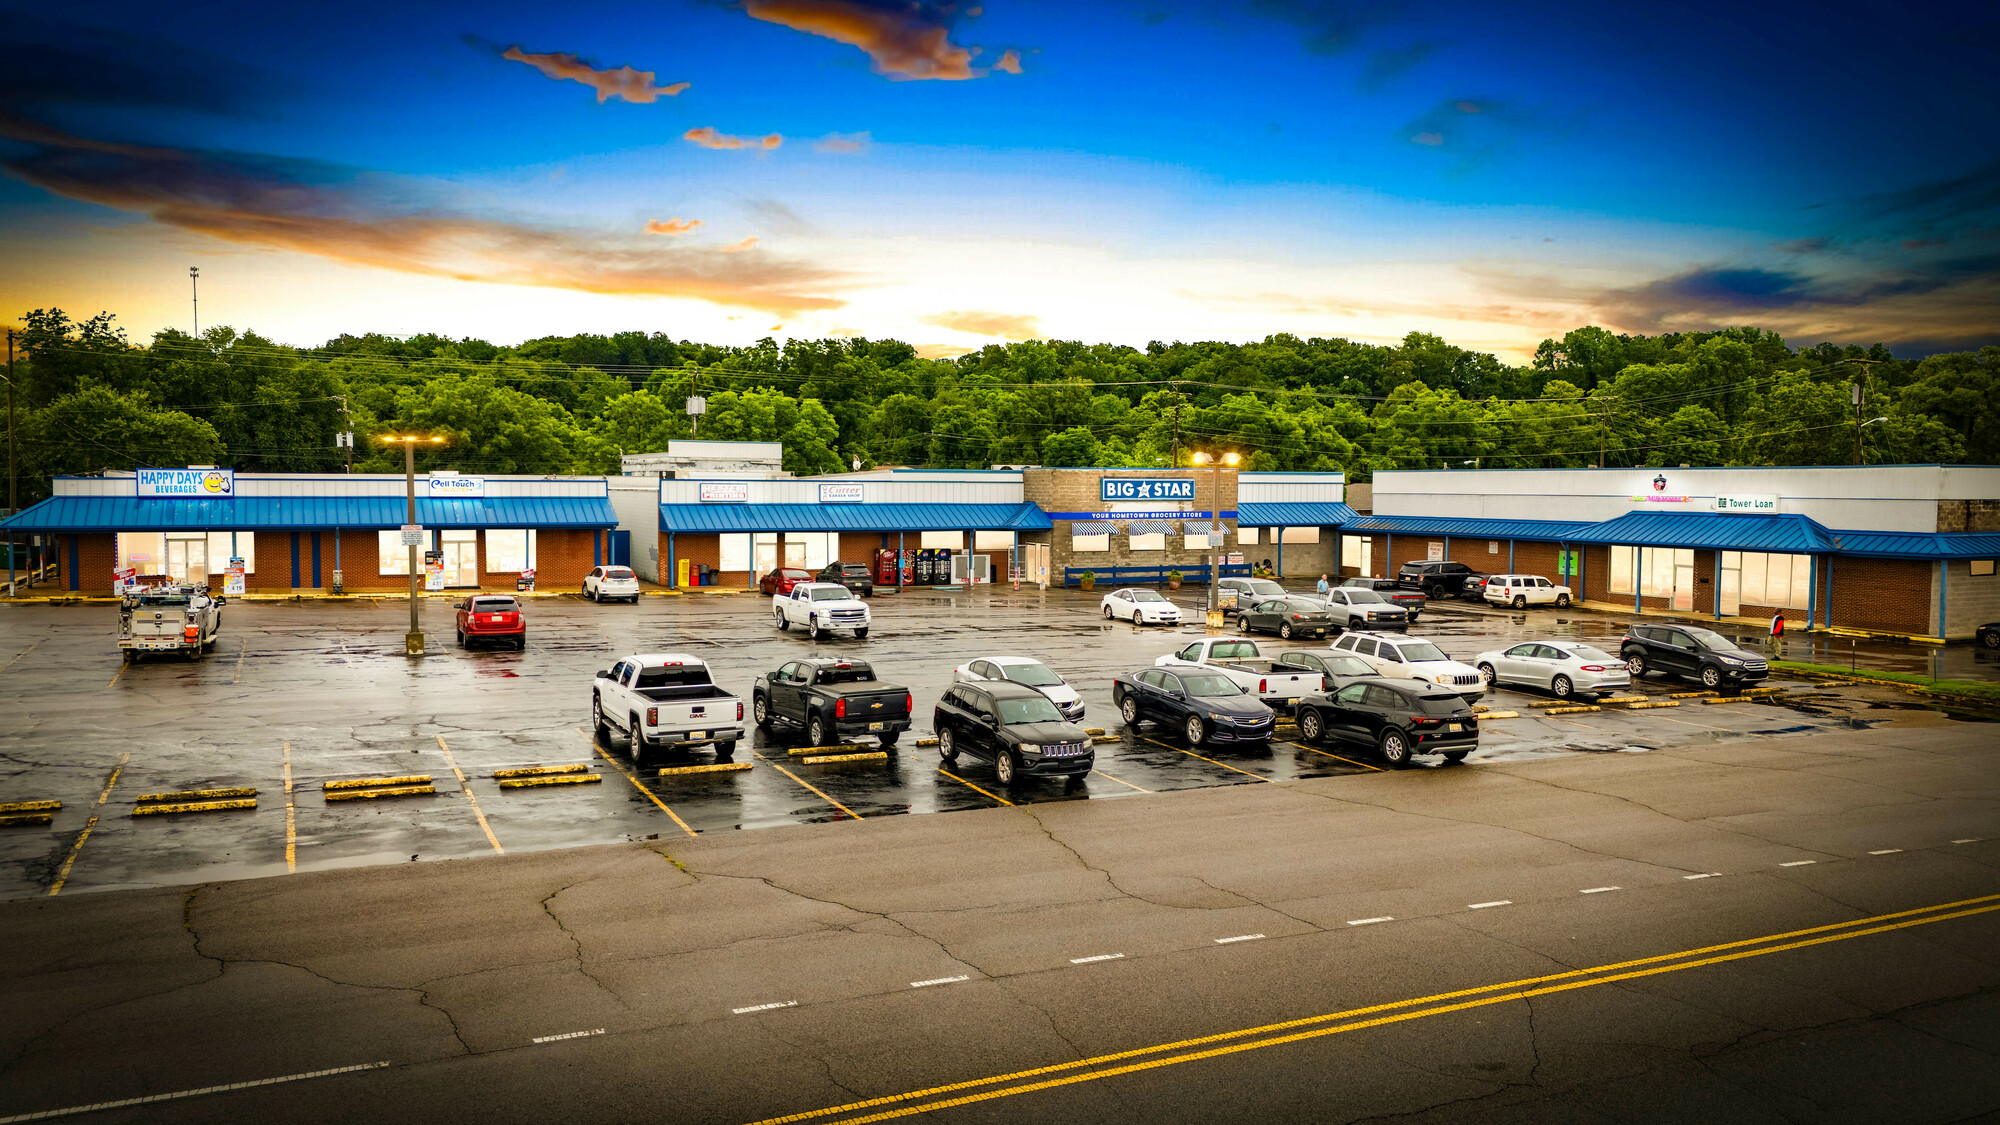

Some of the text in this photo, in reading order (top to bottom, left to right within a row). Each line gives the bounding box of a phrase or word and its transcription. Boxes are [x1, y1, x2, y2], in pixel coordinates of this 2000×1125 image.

[141, 472, 203, 484] HAPPY DAYS
[155, 485, 197, 493] BEVERAGES
[829, 486, 861, 494] Cutter
[1107, 482, 1192, 496] BIG STAR
[1729, 498, 1774, 508] Tower Loan
